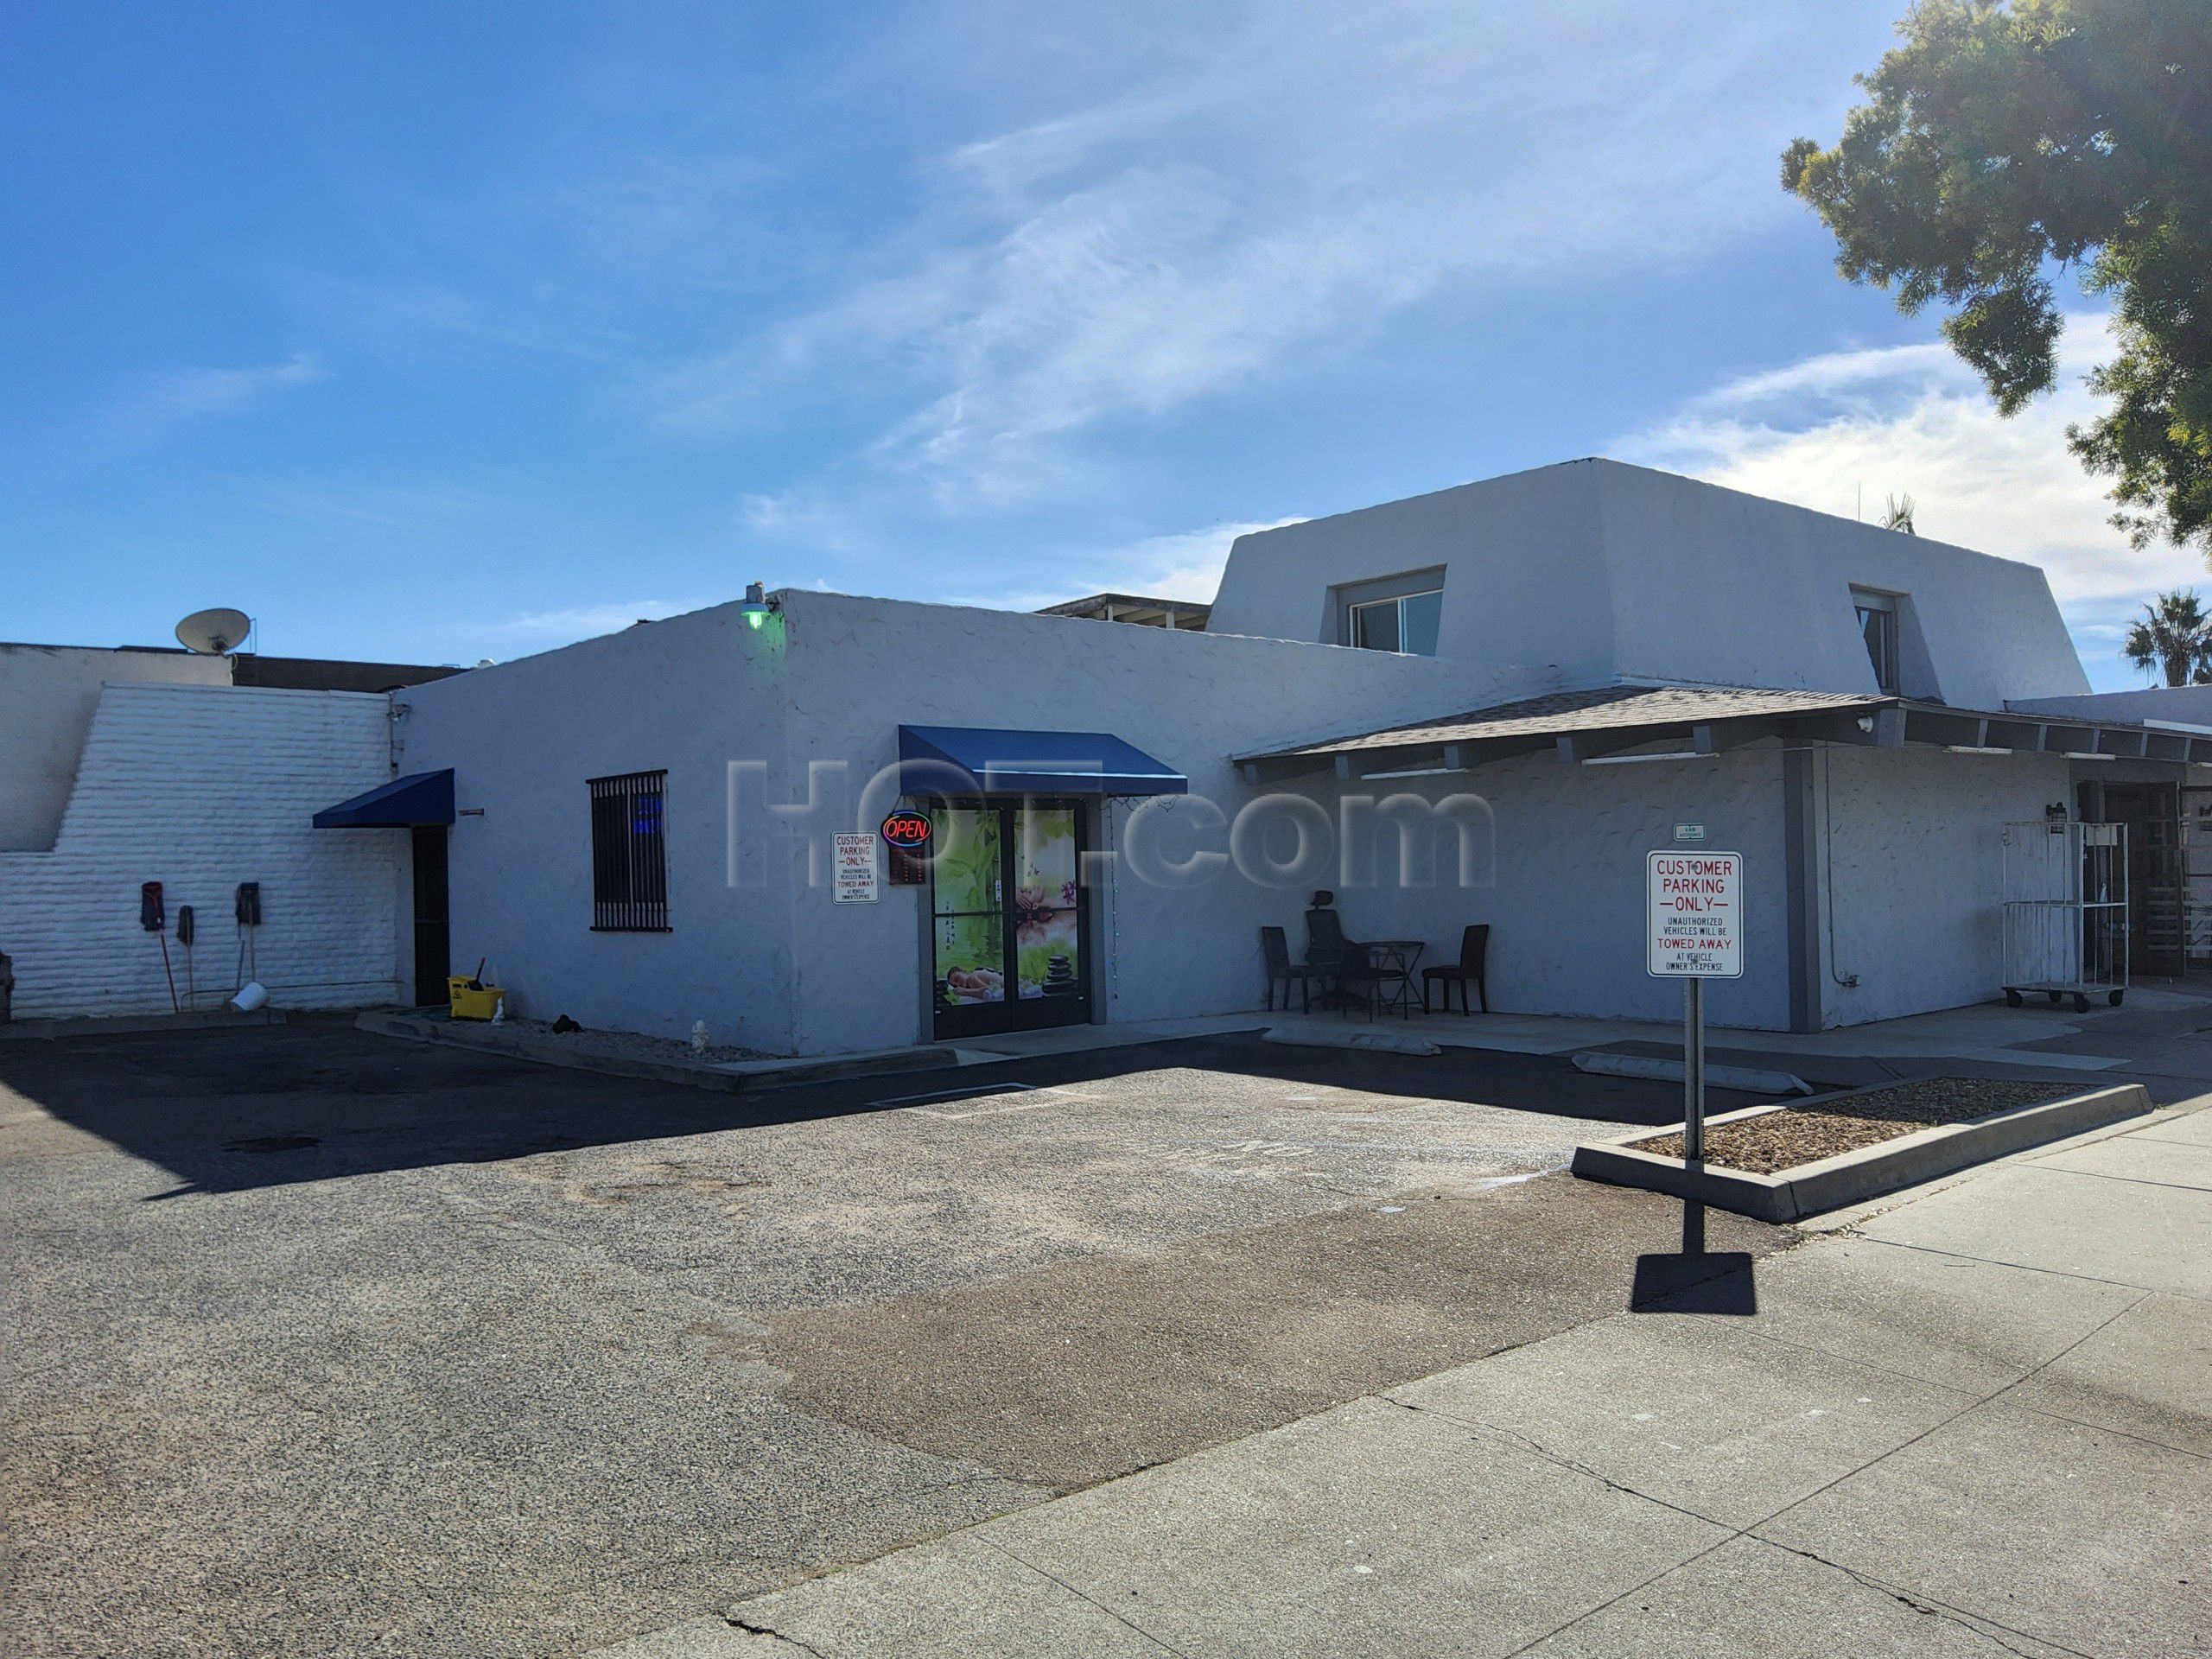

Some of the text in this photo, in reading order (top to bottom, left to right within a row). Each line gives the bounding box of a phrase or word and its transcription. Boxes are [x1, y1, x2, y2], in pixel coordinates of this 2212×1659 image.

[886, 820, 927, 838] OPEN
[836, 836, 874, 845] CUSTOMER
[840, 847, 870, 855] PARKING
[846, 857, 865, 866] ONLY
[1657, 860, 1732, 875] CUSTOMER
[1662, 879, 1725, 893] PARKING
[1675, 897, 1713, 912] ONLY
[1668, 917, 1723, 926] UNAUTHORIZED
[1663, 926, 1726, 936] VEHICLES WILL BE
[1657, 938, 1732, 950] TOWED AWAY
[1676, 952, 1712, 961] AT VEHICLE
[1666, 962, 1724, 971] OWNER'S EXPENSE
